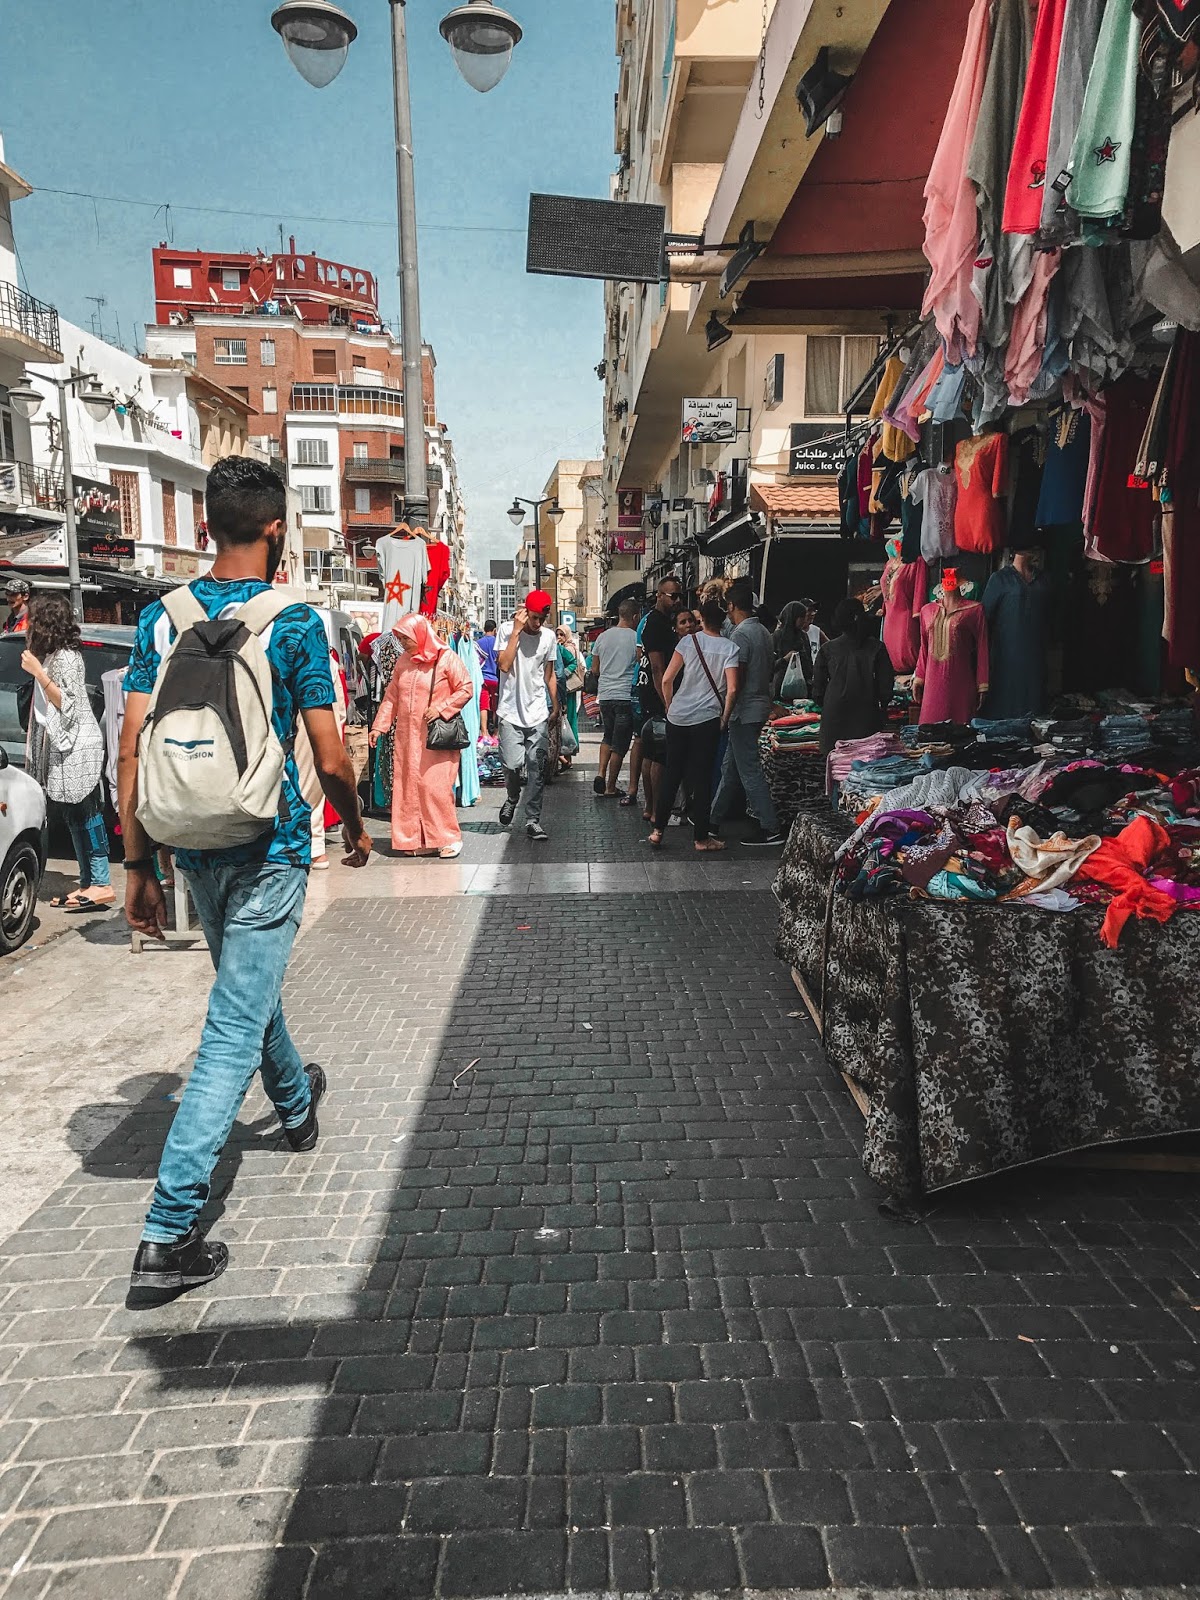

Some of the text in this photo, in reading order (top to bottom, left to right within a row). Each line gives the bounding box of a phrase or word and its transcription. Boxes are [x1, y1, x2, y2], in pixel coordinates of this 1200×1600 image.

[688, 400, 733, 411] تعليم السياقة
[796, 448, 828, 460] مثلجات
[795, 461, 816, 470] Juice
[821, 461, 833, 470] Ice
[562, 614, 574, 625] P
[162, 750, 214, 762] MUNDOVISION
